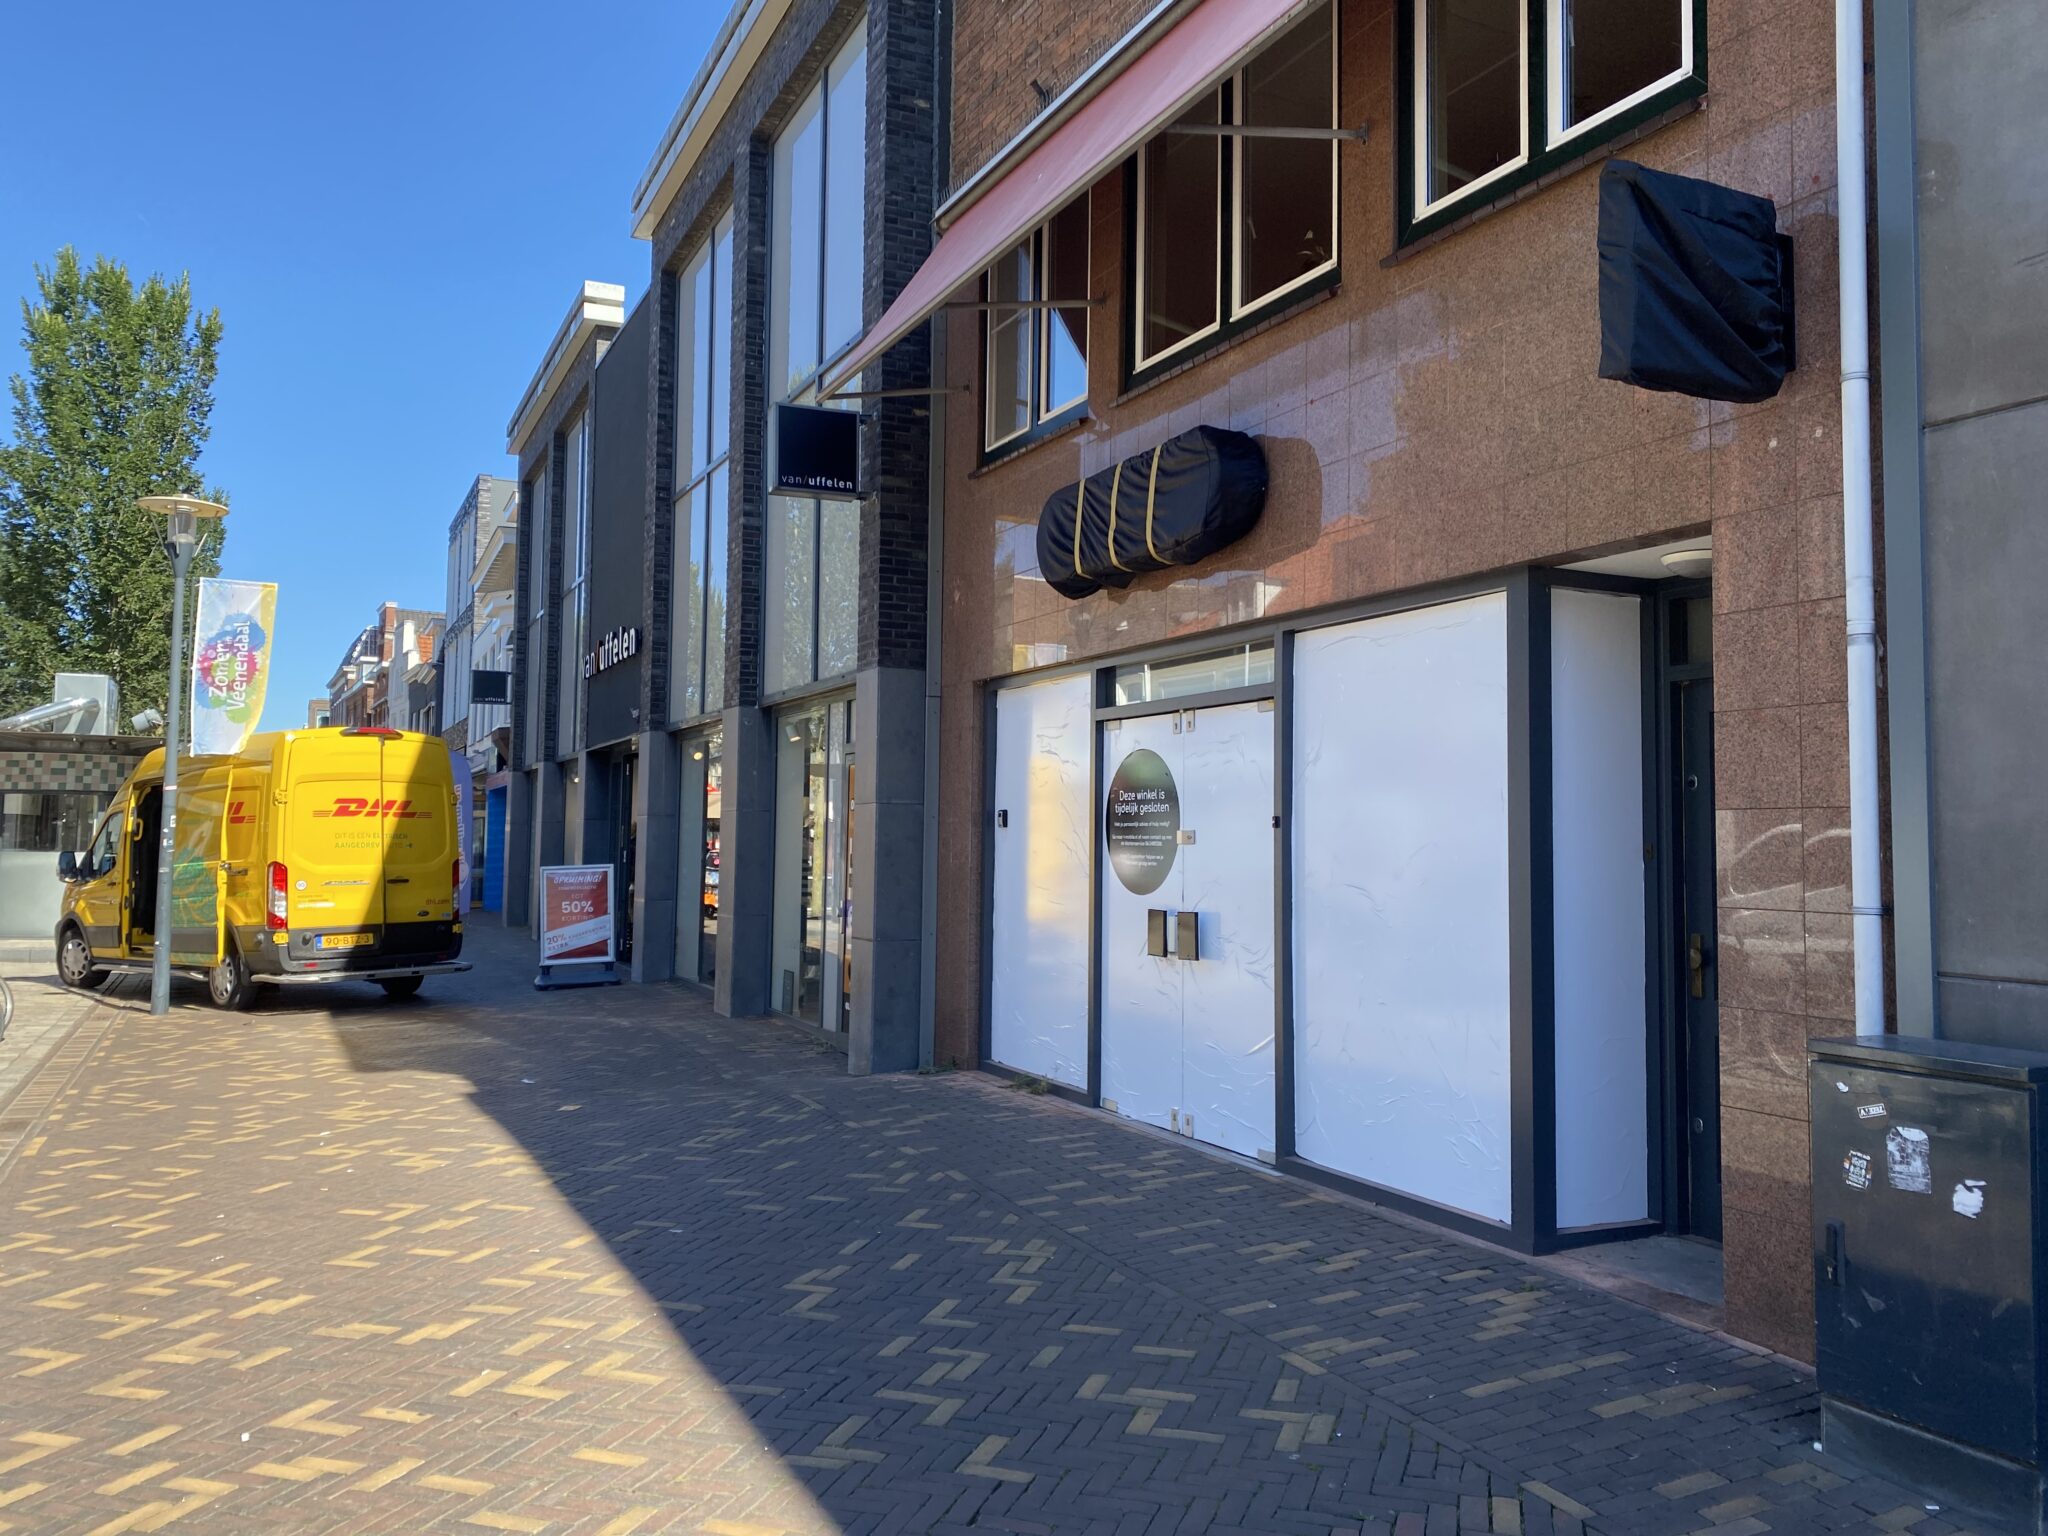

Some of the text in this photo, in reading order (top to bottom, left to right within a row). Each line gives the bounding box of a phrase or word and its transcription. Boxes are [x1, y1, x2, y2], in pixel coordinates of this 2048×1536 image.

[781, 474, 853, 490] van/uffelen
[208, 641, 230, 698] Zomer
[226, 620, 251, 711] Veenendaal
[1119, 788, 1166, 801] Deze winkel is
[331, 797, 418, 819] DHL
[1114, 801, 1170, 816] tijdelijk gesloten
[561, 900, 594, 913] 50%
[325, 935, 370, 946] 90-BTZ-3
[546, 933, 567, 945] 20%
